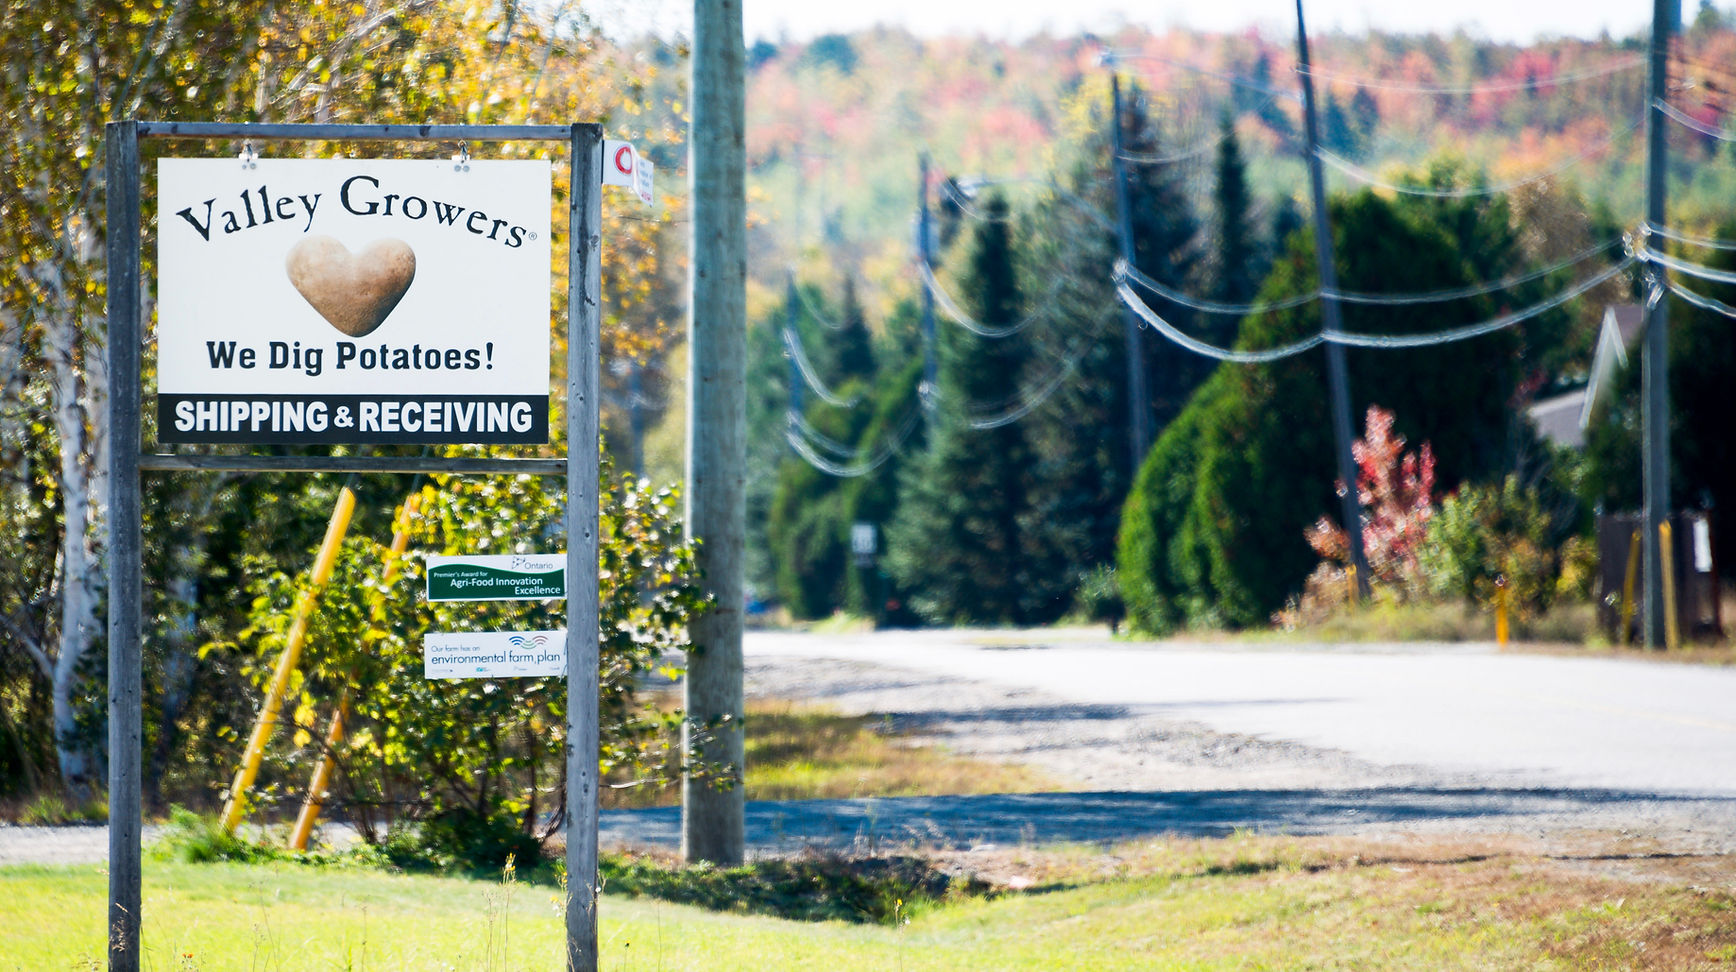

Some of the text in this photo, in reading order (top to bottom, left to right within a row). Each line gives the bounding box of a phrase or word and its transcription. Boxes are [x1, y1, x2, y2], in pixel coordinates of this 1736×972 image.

[175, 184, 322, 242] Valley
[206, 341, 494, 377] We Dig Potatoes!
[174, 400, 533, 433] SHIPPING & RECEIVING
[524, 561, 554, 570] Ontario
[450, 576, 543, 589] Agri-Food Innovation
[514, 586, 561, 595] Excellence
[431, 650, 506, 665] environmental
[537, 649, 560, 665] plan
